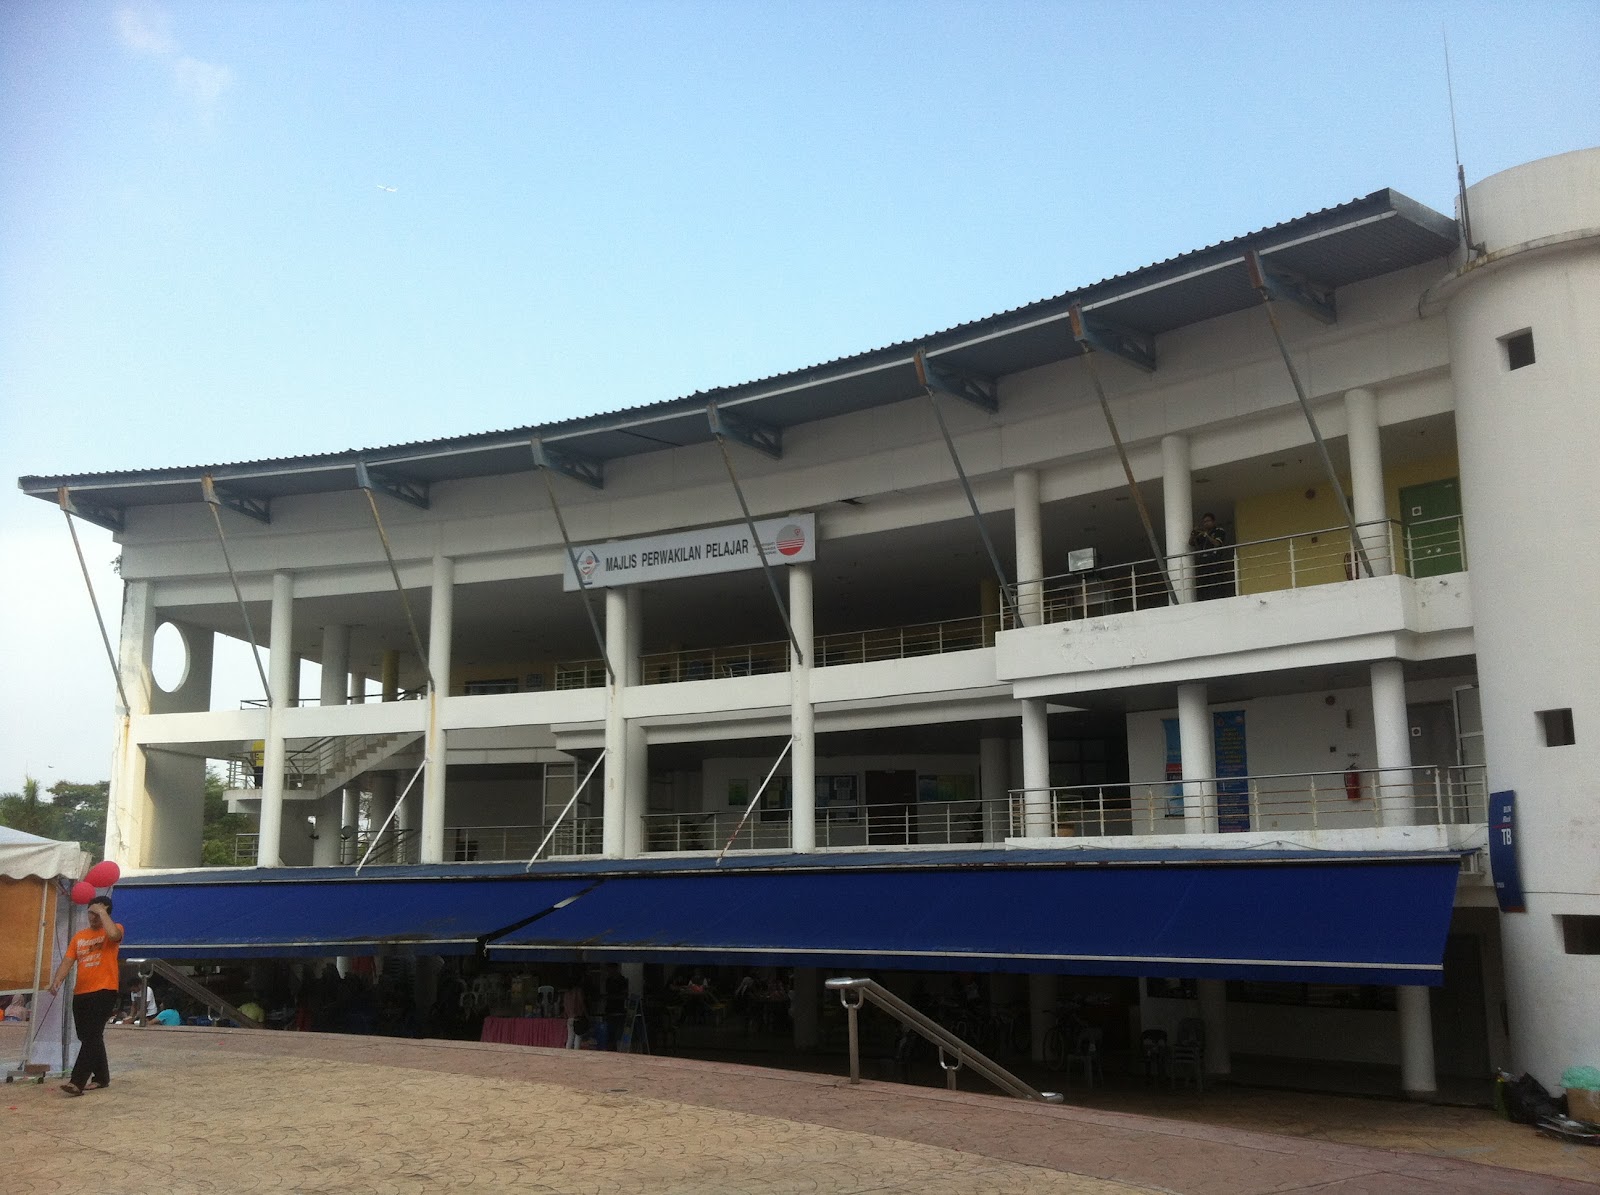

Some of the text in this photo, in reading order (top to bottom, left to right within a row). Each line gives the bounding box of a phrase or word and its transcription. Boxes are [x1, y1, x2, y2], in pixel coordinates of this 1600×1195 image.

[605, 553, 637, 572] MAJLIS
[641, 545, 702, 567] PERWAKILAN
[706, 539, 749, 558] PELAJAR
[1501, 828, 1512, 845] TB
